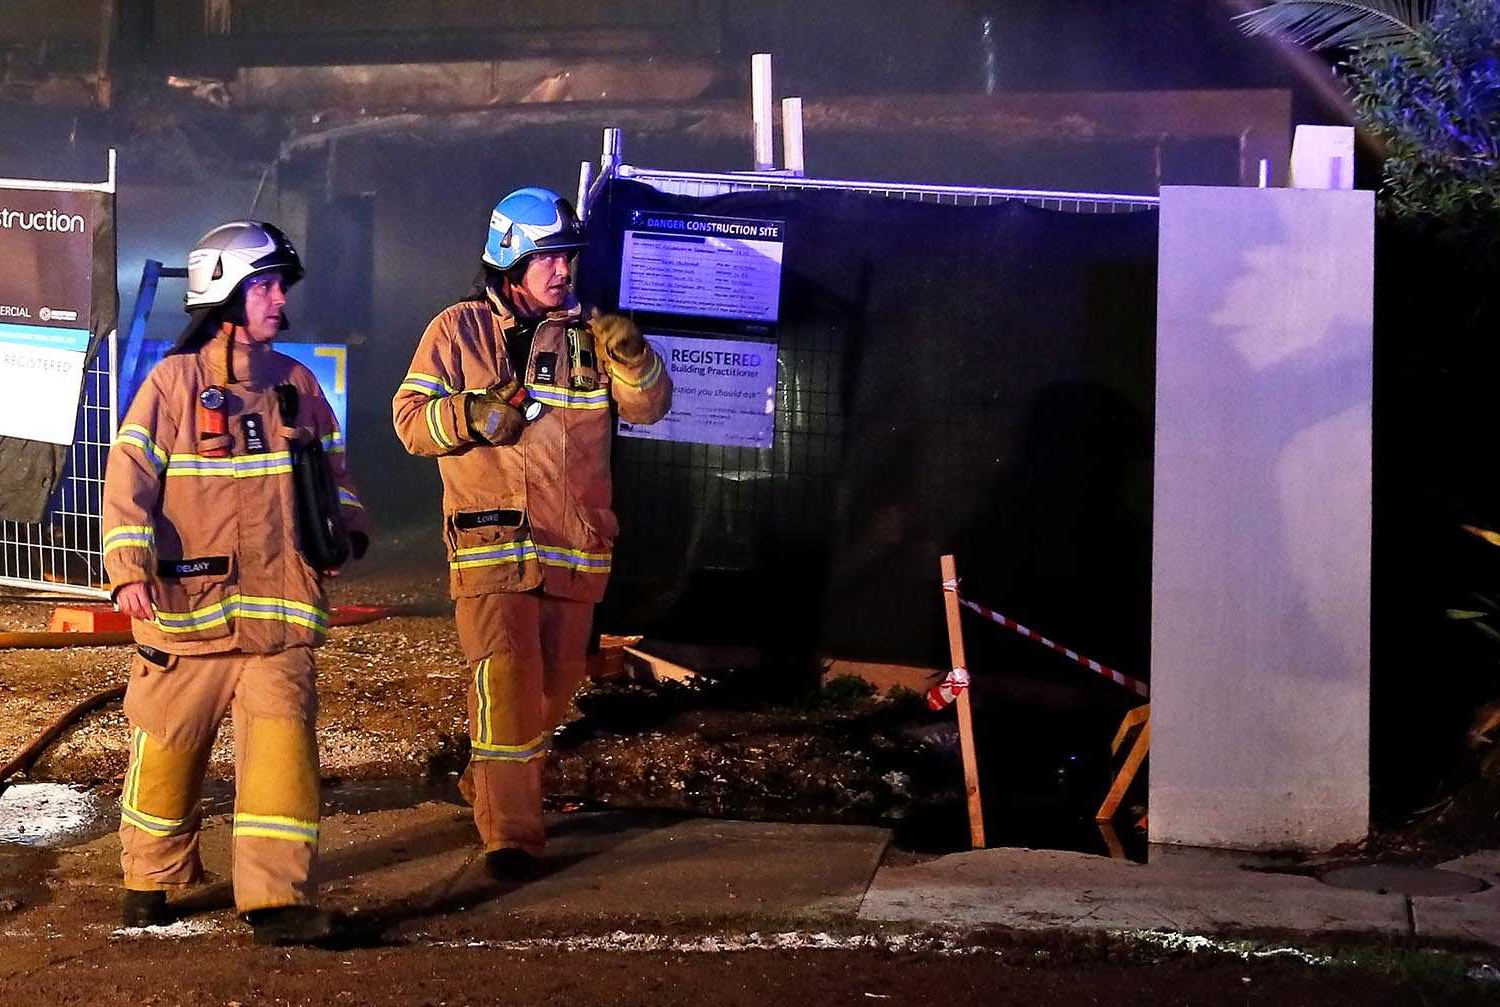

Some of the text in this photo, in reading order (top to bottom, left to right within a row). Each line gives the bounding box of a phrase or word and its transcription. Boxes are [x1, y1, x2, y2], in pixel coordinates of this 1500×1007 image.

[646, 218, 779, 237] DANGER CONSTRUCTION SITE
[4, 353, 72, 374] REGISTERED
[671, 348, 761, 367] REGISTERED
[671, 364, 759, 378] Building Practitioner
